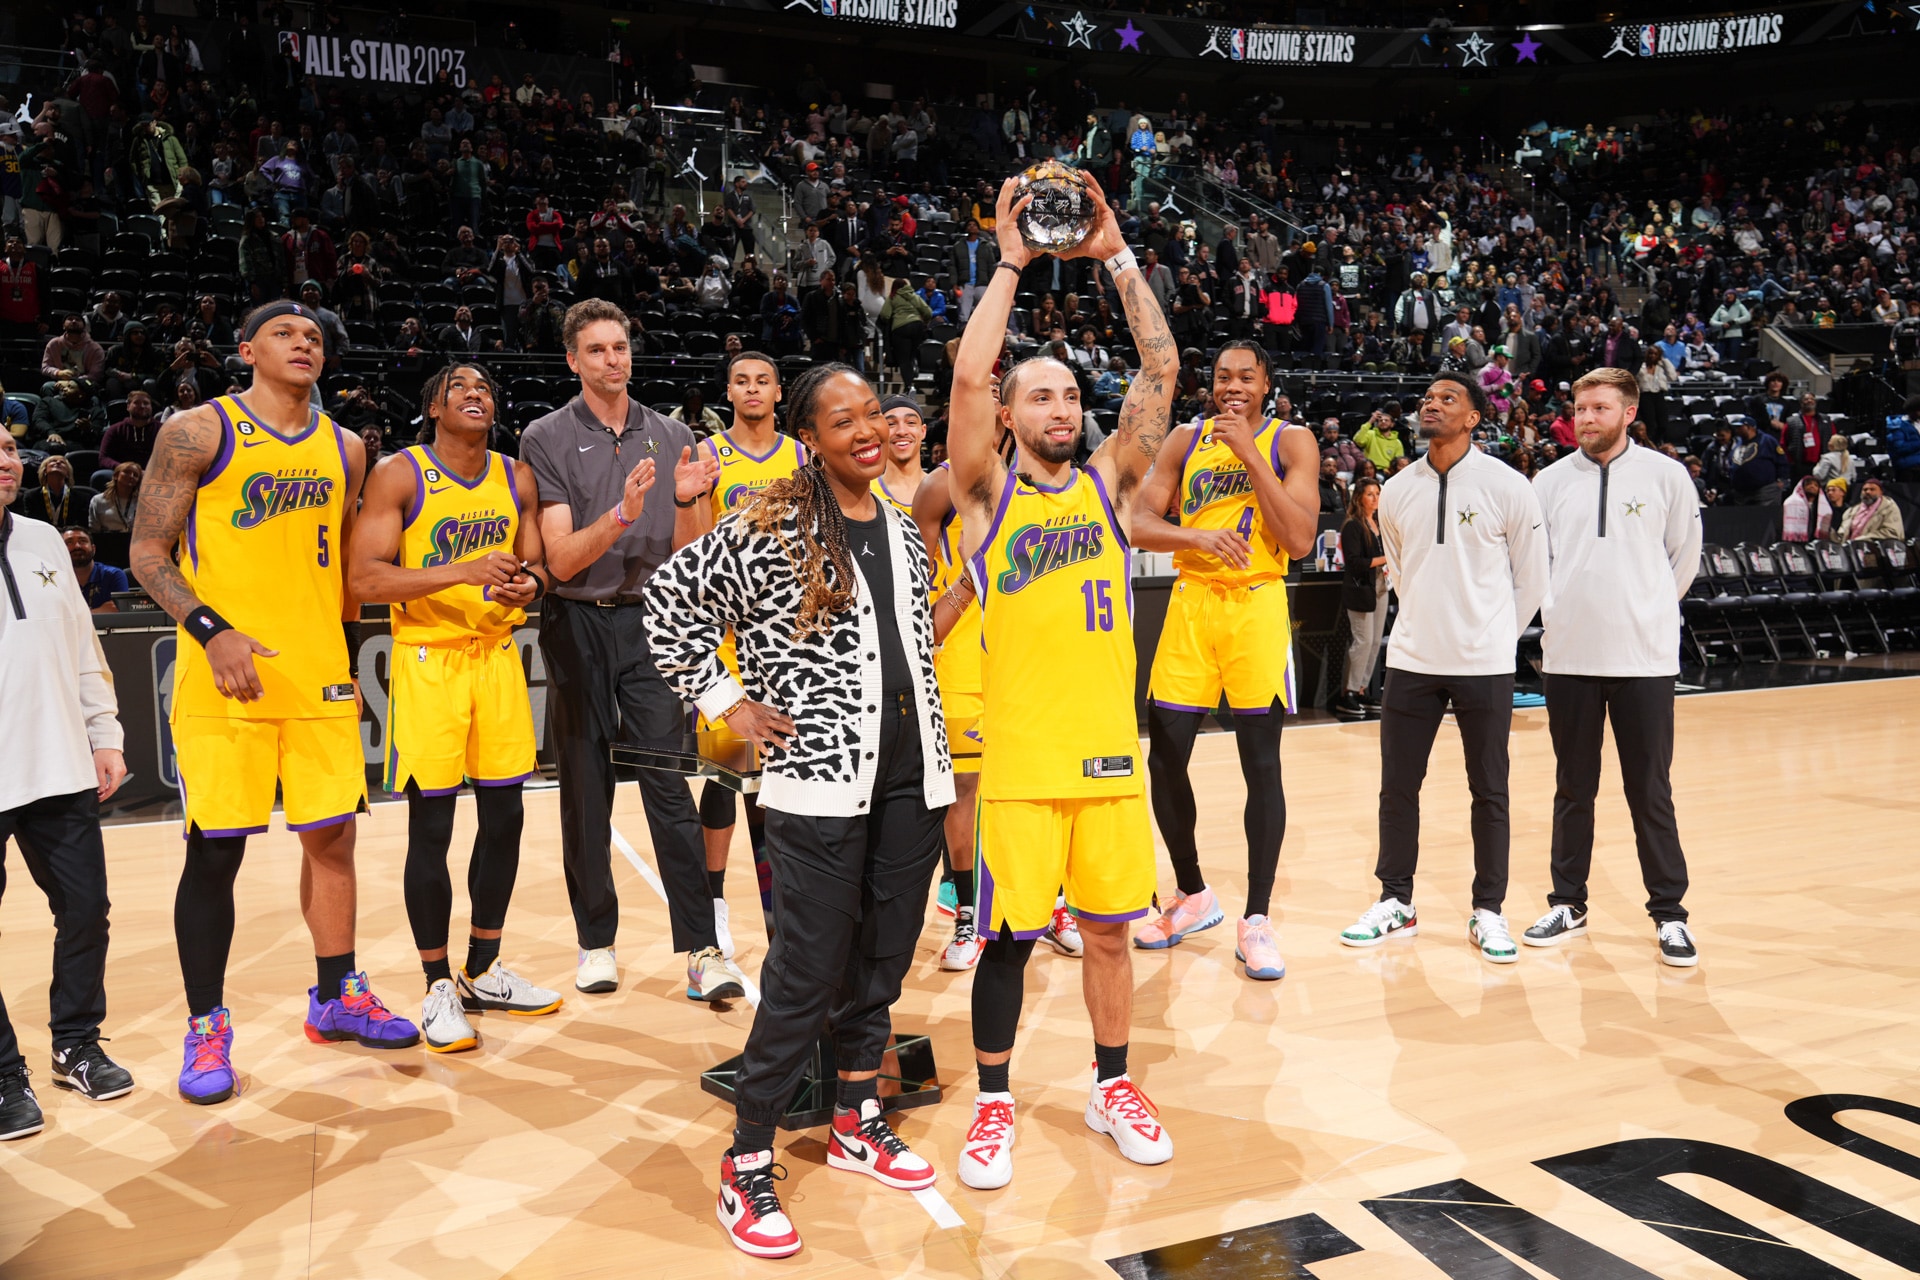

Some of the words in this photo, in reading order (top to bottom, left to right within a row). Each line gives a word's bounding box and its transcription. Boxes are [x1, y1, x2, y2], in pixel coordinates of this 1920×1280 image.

[904, 0, 958, 28] STARS
[1246, 31, 1302, 61] RISING
[1304, 34, 1355, 62] STARS
[1657, 21, 1720, 53] RISING
[1723, 14, 1784, 48] STARS
[239, 422, 252, 434] 6
[1203, 434, 1212, 444] 6
[721, 447, 731, 456] 6
[277, 468, 318, 477] RISING
[426, 470, 438, 482] 6
[1215, 463, 1247, 472] RISIN
[231, 472, 335, 530] STARS
[460, 509, 495, 520] RISING
[1045, 513, 1087, 528] RISING
[1236, 506, 1255, 542] 4
[317, 524, 330, 568] 5
[422, 515, 510, 568] STARS
[997, 521, 1104, 595] STARS
[1080, 579, 1114, 632] 15
